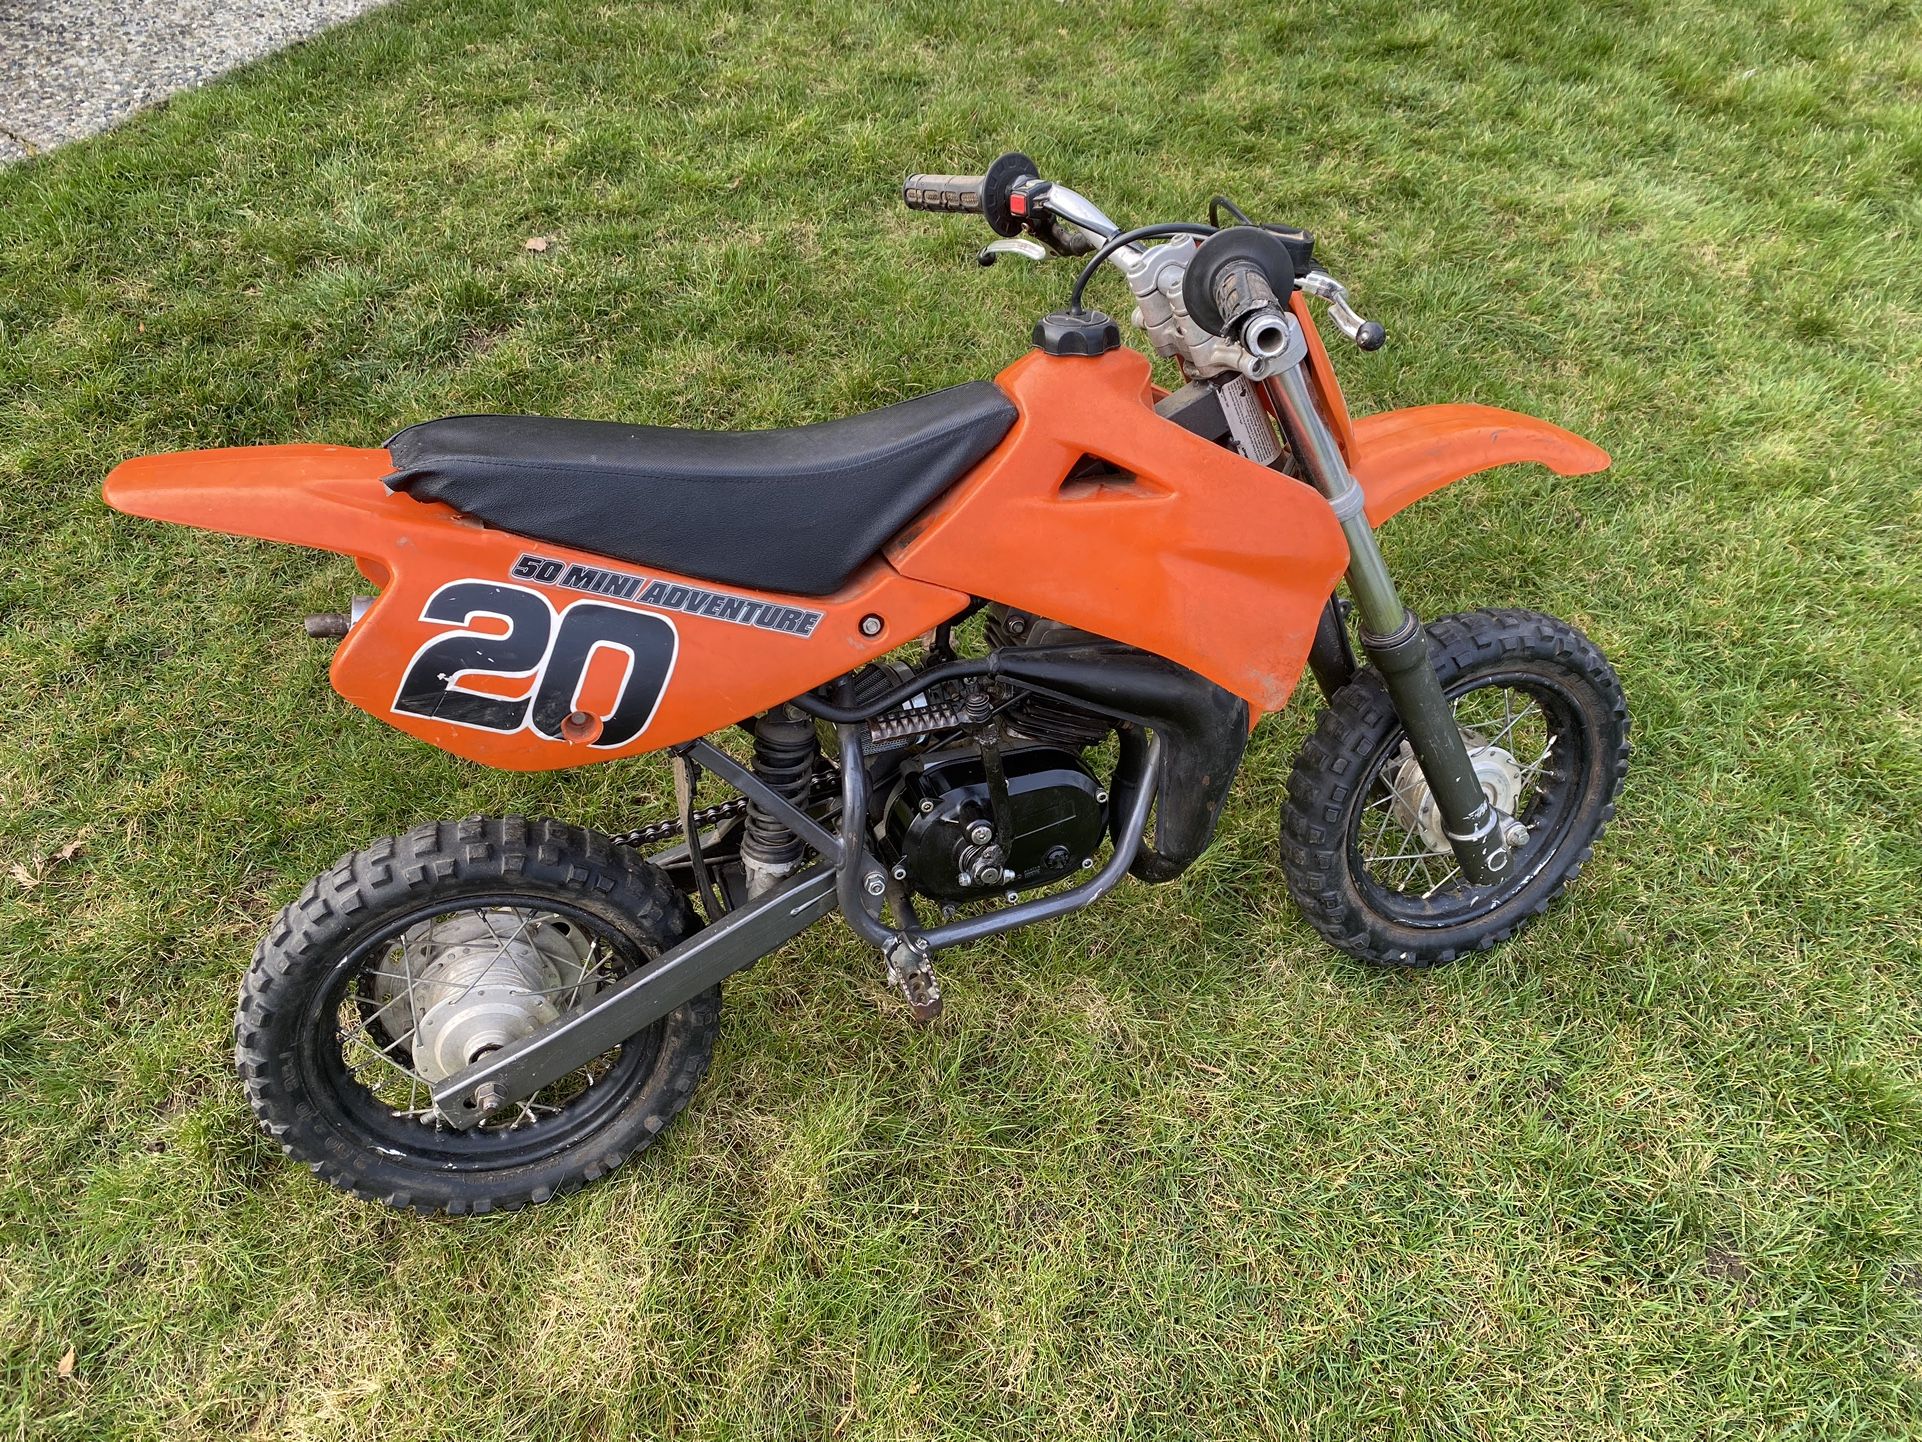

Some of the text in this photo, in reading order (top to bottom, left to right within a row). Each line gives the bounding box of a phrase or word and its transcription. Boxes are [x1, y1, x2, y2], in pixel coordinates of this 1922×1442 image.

[511, 554, 823, 637] 50 MINI ADVENTURE
[390, 578, 679, 749] 20
